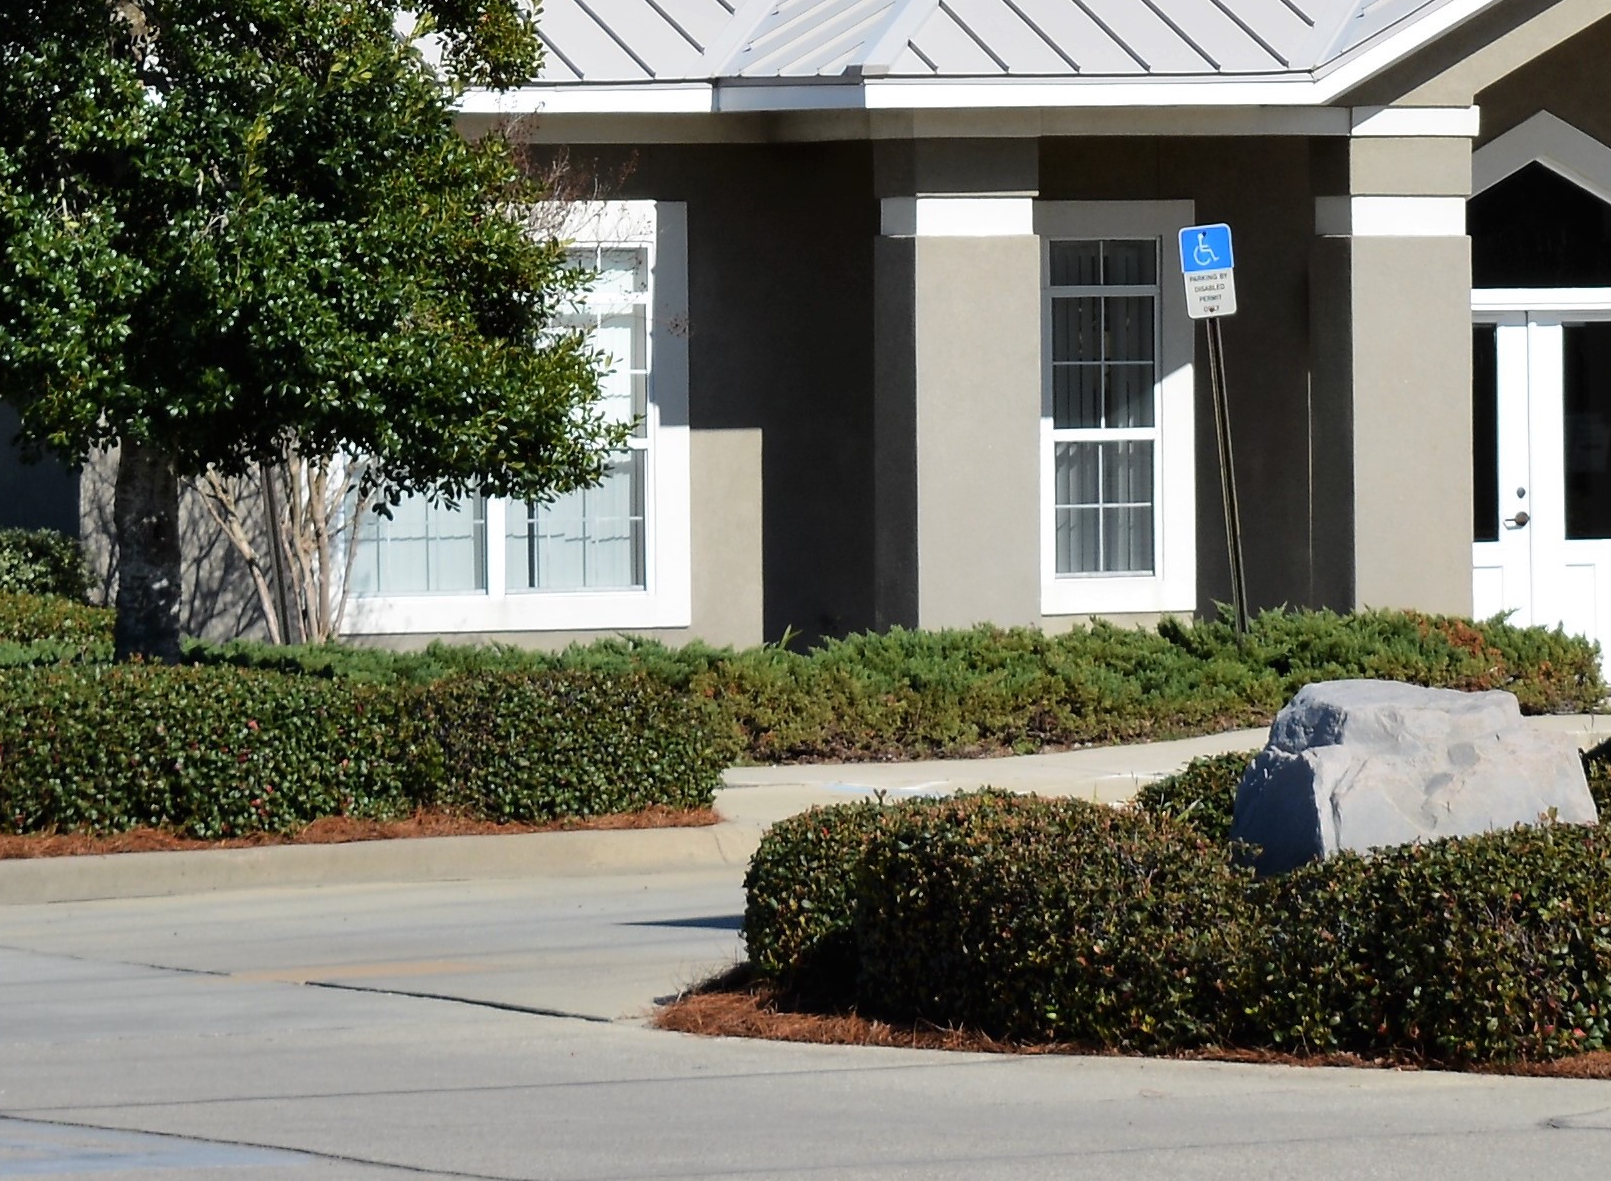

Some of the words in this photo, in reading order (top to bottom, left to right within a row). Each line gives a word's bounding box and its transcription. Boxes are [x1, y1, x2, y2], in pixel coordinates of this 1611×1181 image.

[1189, 274, 1217, 282] PARKING
[1194, 284, 1225, 292] DISABLED
[1199, 294, 1221, 302] PERMIT
